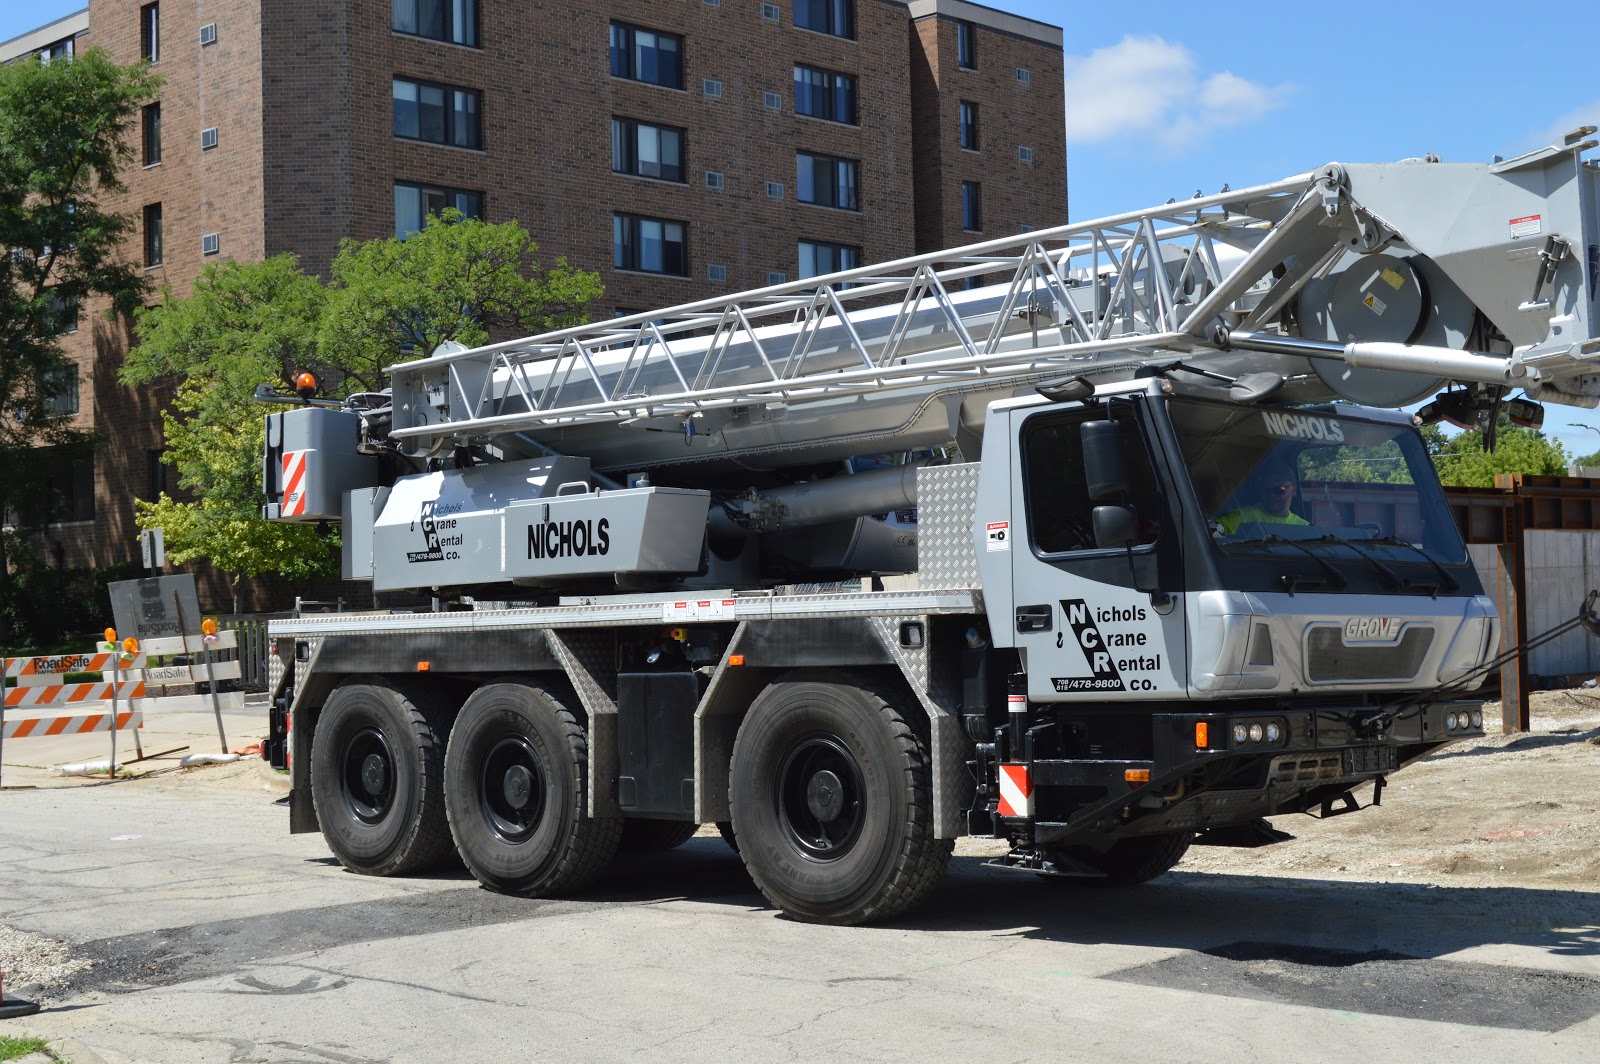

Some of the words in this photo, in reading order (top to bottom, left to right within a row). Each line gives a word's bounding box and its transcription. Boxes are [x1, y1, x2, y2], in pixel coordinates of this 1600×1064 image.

[1262, 411, 1345, 443] NICHOLS
[527, 517, 610, 560] NICHOLS
[446, 551, 461, 560] co.
[1345, 617, 1401, 639] GROVE
[33, 655, 90, 670] RoadSafe
[1129, 678, 1158, 692] co.
